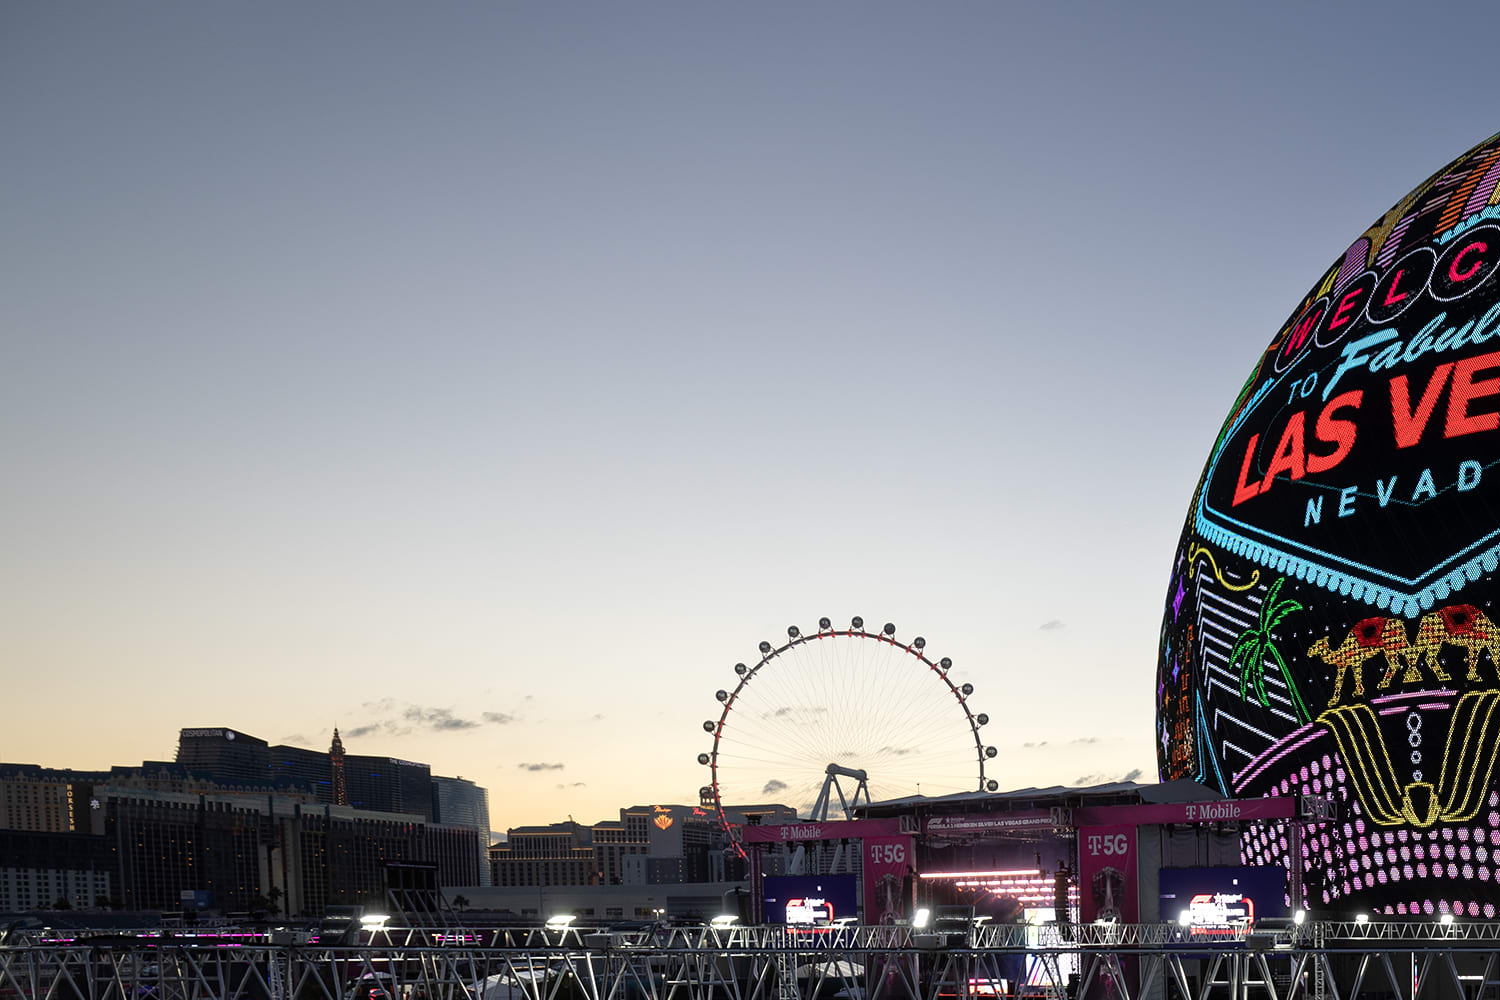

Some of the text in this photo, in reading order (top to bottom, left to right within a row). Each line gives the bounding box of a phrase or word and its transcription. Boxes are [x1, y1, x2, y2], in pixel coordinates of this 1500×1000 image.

[1289, 372, 1318, 403] TO
[1233, 391, 1363, 507] LAS
[1199, 804, 1241, 819] Mobile
[791, 825, 821, 839] Mobile
[884, 844, 905, 863] 5G
[1102, 834, 1128, 855] 5G
